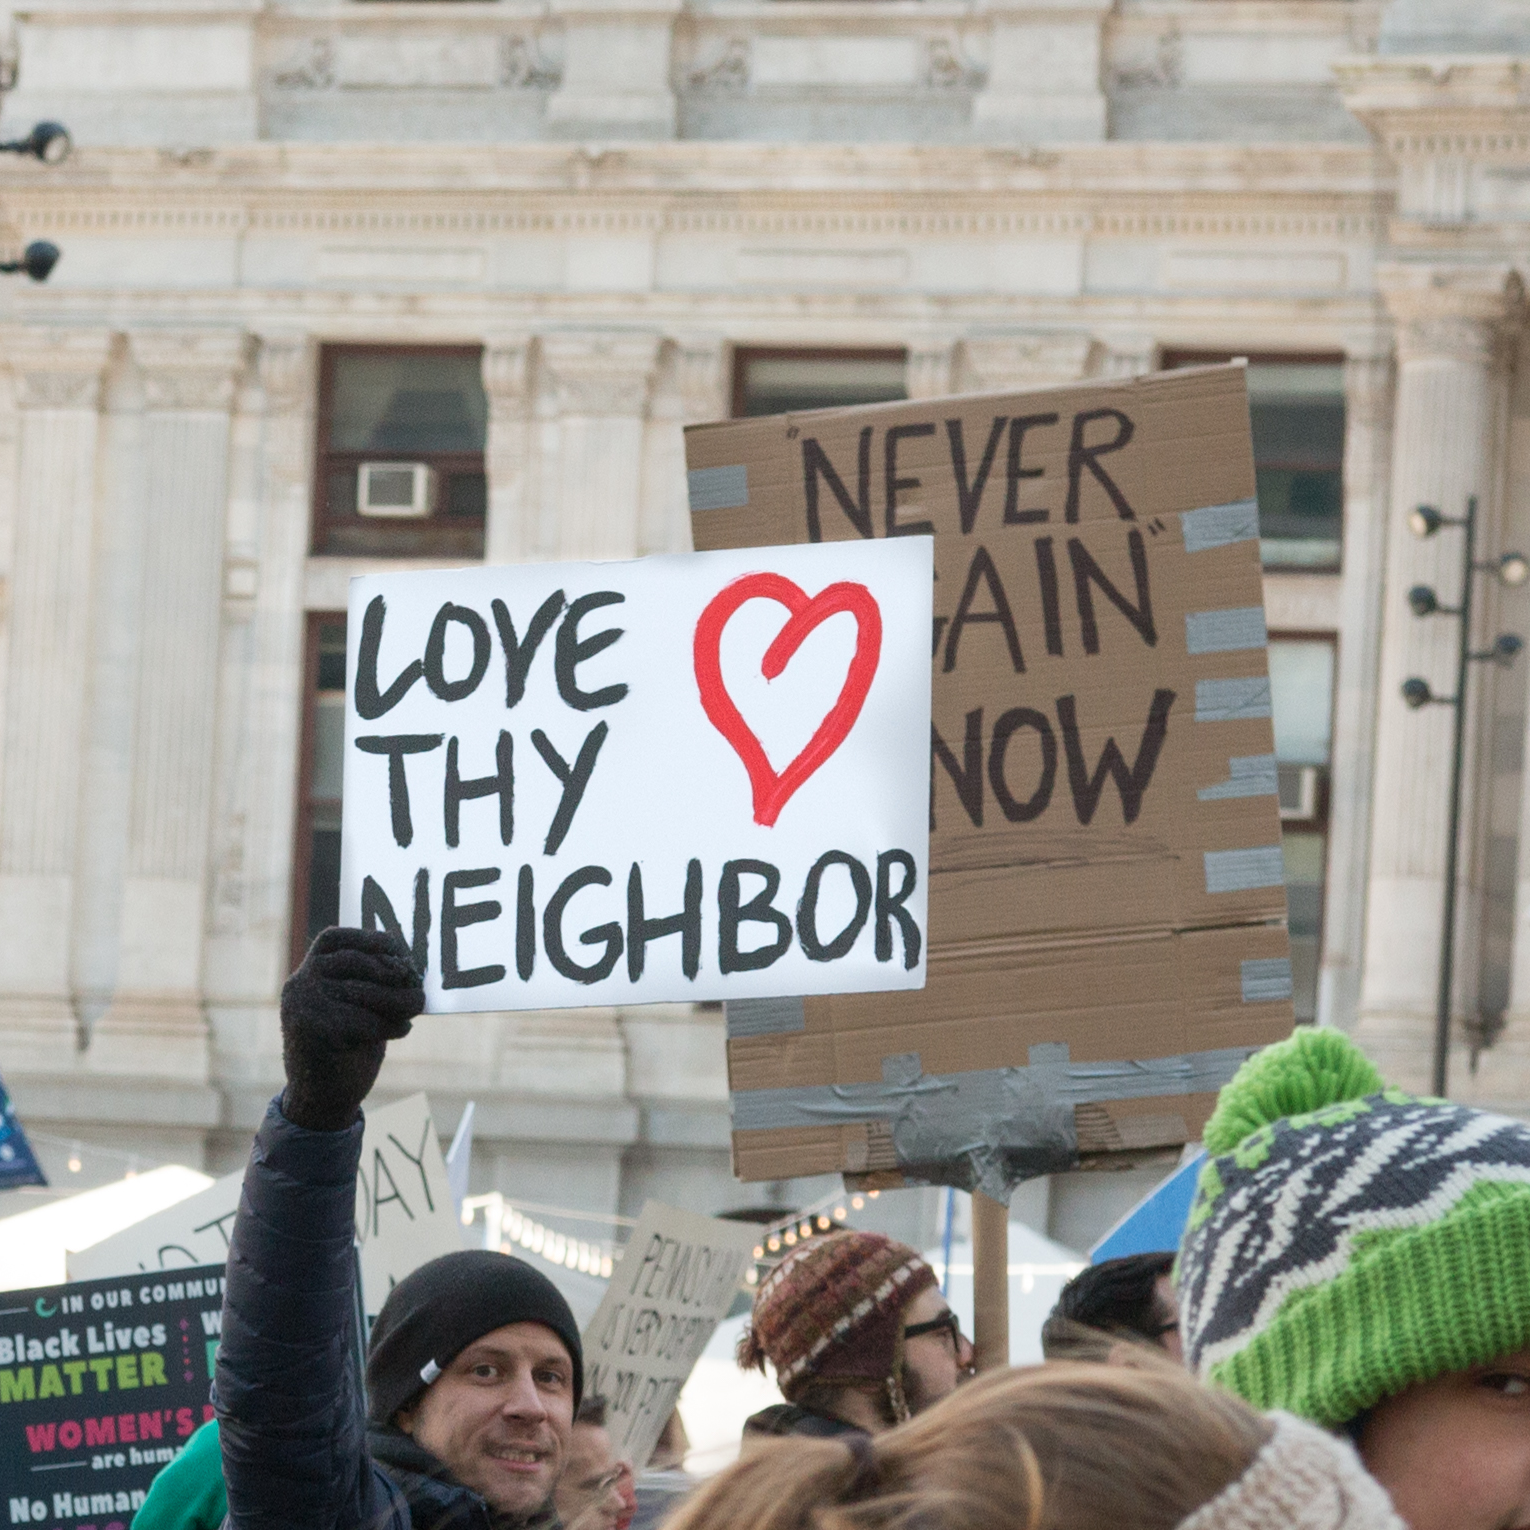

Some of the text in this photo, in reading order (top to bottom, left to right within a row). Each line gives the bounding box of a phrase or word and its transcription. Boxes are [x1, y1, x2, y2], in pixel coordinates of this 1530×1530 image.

[354, 588, 630, 720] LOVE
[354, 720, 609, 857] THY
[359, 848, 922, 990] NEIGHBOR
[61, 1295, 85, 1315] IN
[90, 1288, 133, 1311] OUR
[86, 1320, 168, 1353] Lives
[25, 1407, 196, 1453] WOMEN'S
[91, 1444, 184, 1475] are hum
[9, 1489, 148, 1524] No Human
